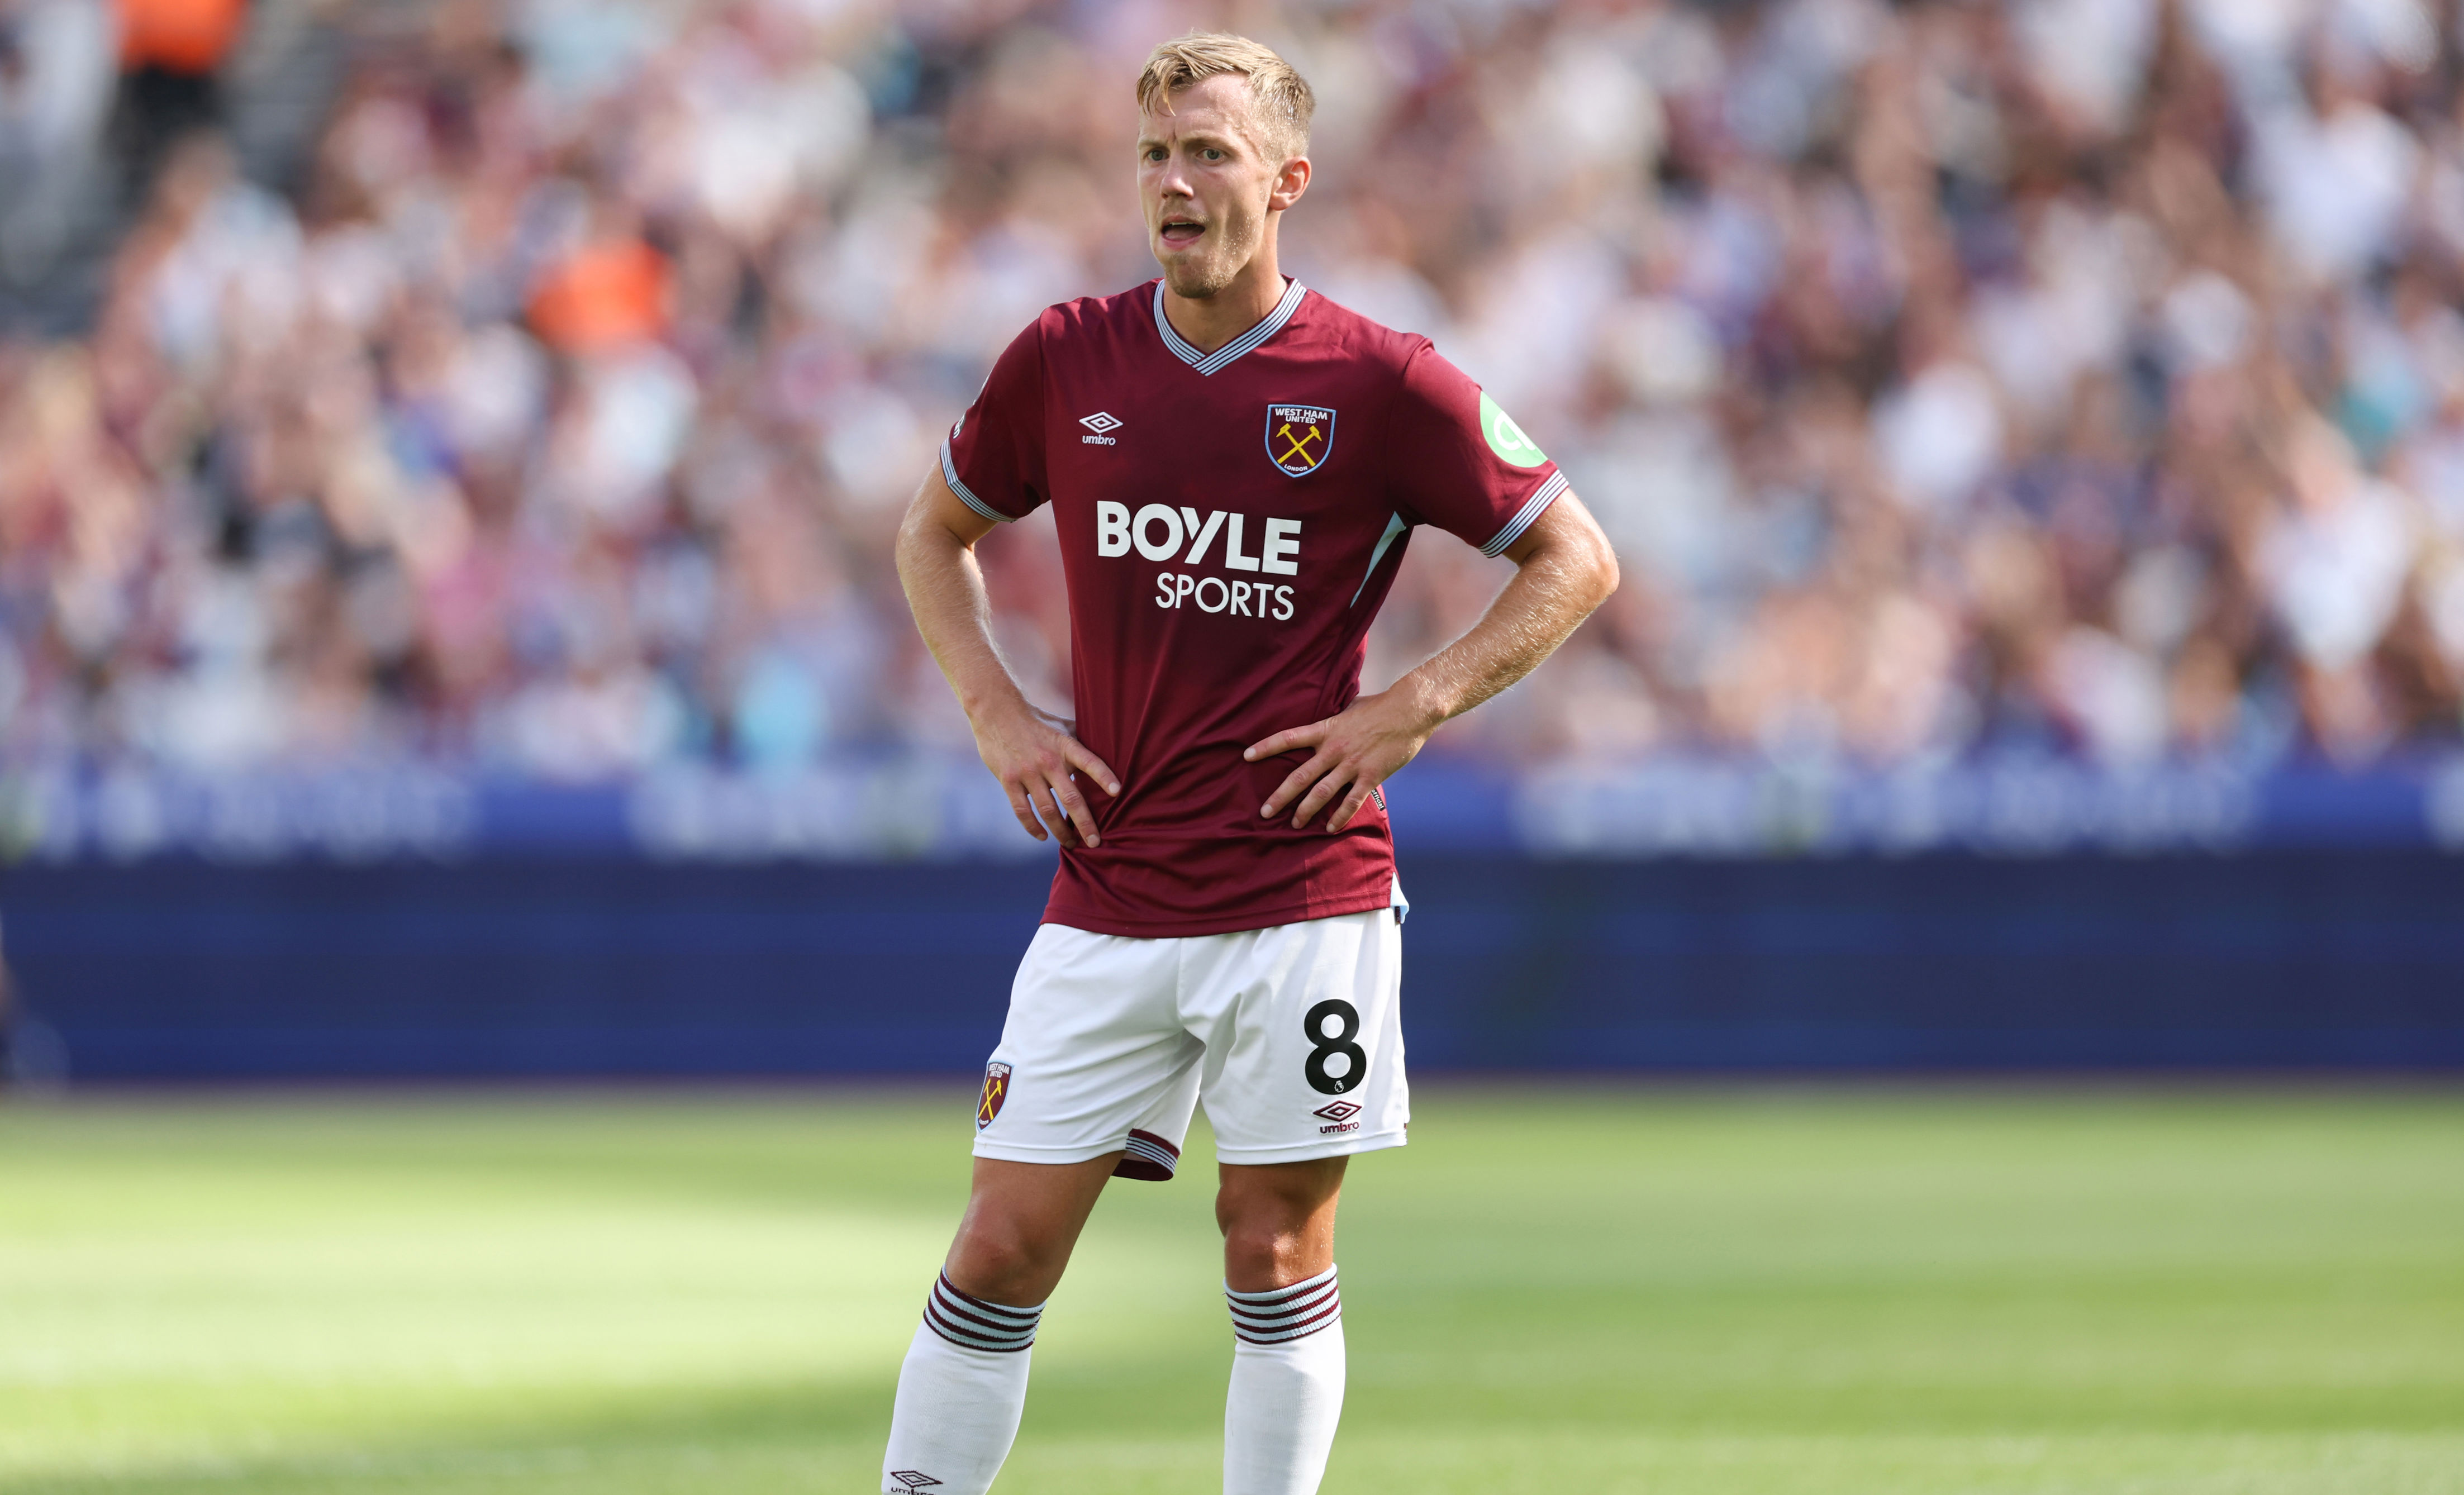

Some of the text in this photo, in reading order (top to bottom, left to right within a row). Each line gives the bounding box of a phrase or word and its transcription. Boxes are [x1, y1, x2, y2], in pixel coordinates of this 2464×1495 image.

[1275, 408, 1328, 420] WEST HAM
[1286, 416, 1316, 424] UNITED
[1082, 434, 1116, 445] umbro
[1097, 500, 1302, 575] BOYLE
[1155, 572, 1295, 621] SPORTS
[1304, 999, 1367, 1095] 8
[997, 1064, 1010, 1074] HAM
[1320, 1122, 1359, 1134] umbro
